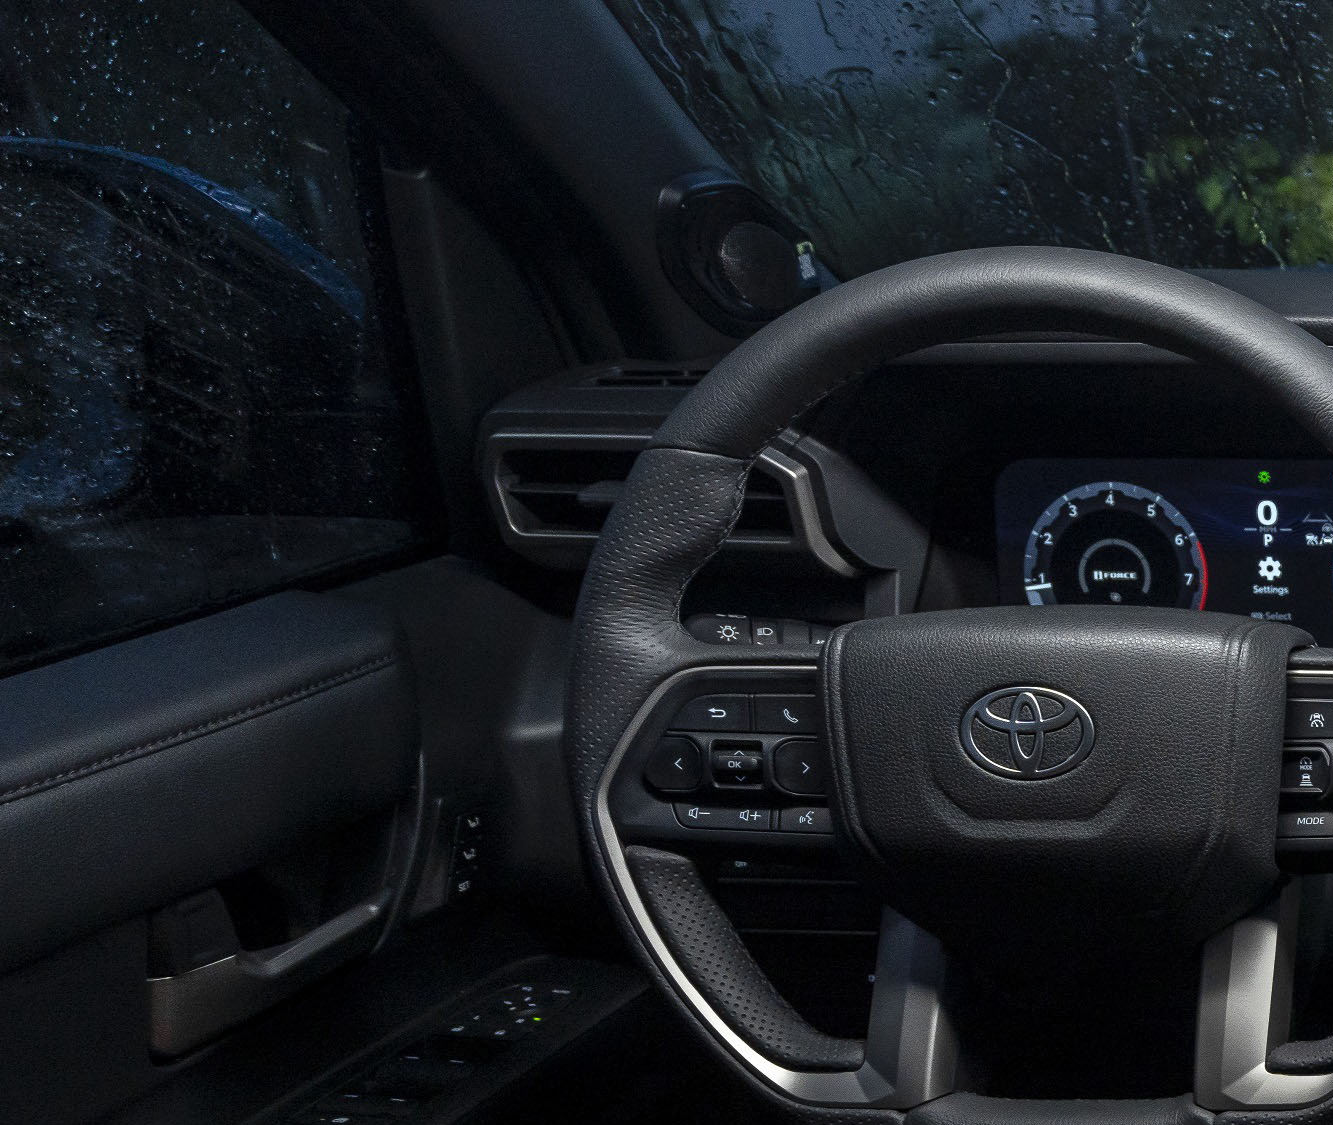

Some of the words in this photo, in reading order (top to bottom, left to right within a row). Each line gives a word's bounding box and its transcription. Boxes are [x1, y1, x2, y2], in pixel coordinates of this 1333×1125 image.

[1106, 494, 1114, 506] 4
[1069, 505, 1077, 517] 3
[1147, 505, 1156, 517] 5
[1257, 501, 1277, 525] 0
[1044, 533, 1052, 545] 2
[1174, 534, 1183, 546] 6
[1264, 534, 1273, 546] P
[1038, 573, 1046, 584] 1
[1184, 574, 1193, 586] 7
[1253, 585, 1289, 596] Settings
[728, 760, 742, 769] OK
[1297, 817, 1325, 825] MODE
